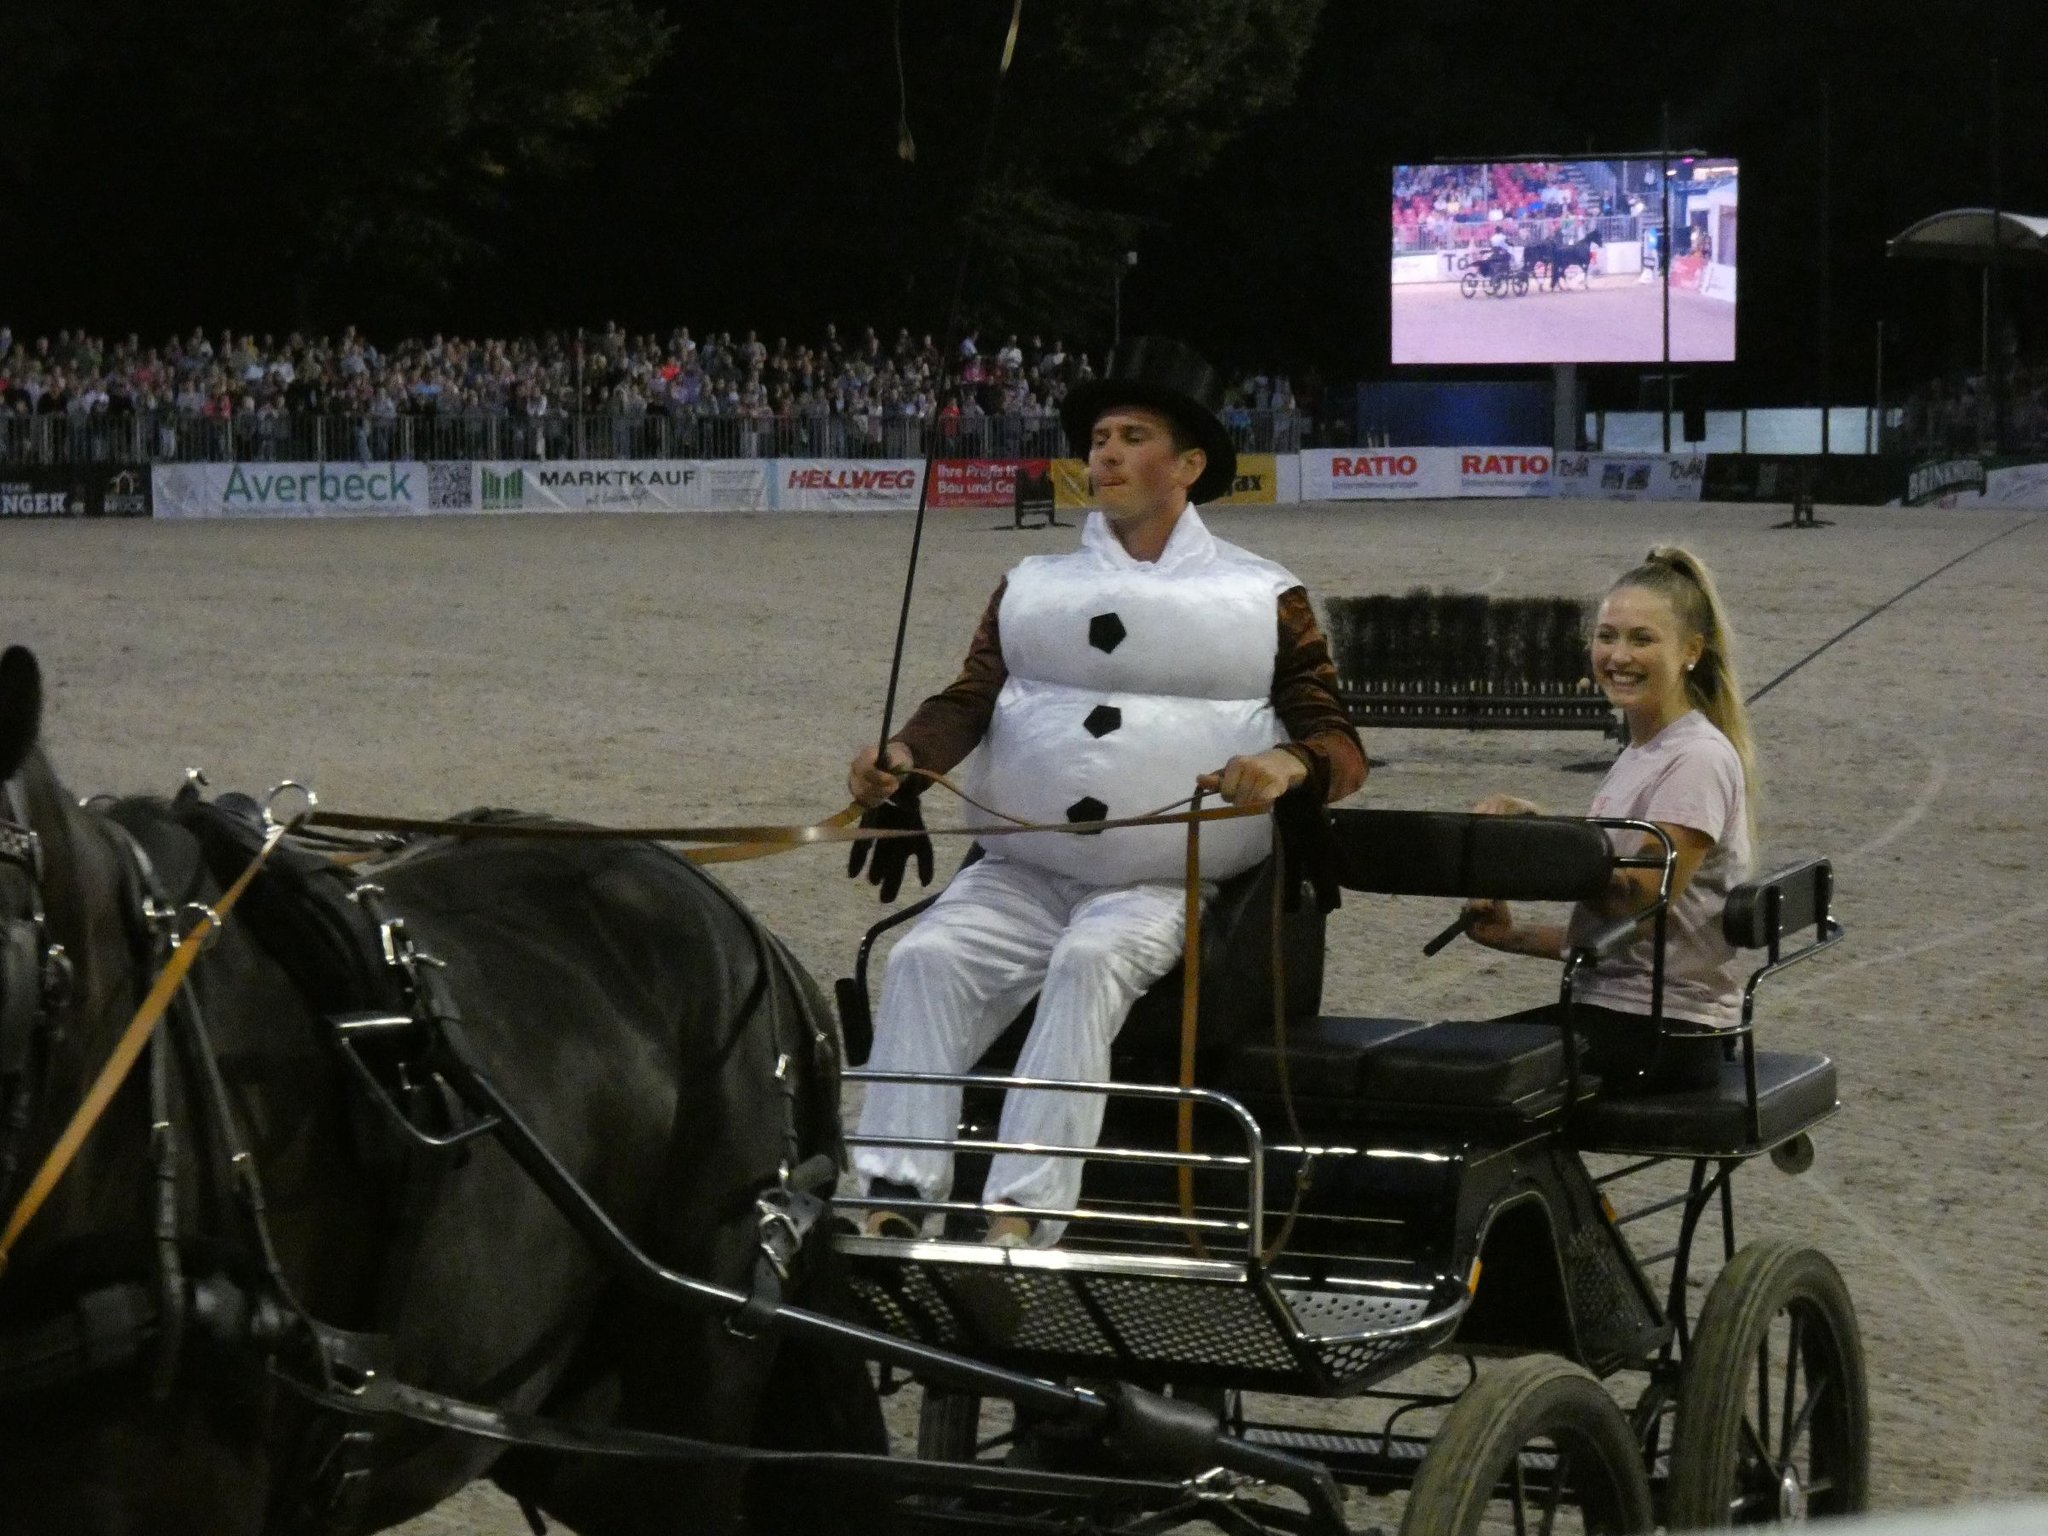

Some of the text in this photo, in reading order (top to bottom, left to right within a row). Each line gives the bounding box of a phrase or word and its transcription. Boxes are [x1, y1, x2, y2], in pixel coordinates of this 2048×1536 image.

[938, 464, 963, 478] Ihre
[1331, 455, 1418, 477] RATIO
[1462, 454, 1550, 475] RATIO
[222, 463, 412, 503] Averbeck
[539, 470, 697, 487] MARKTKAUF
[788, 469, 916, 489] HELLWEG
[938, 480, 963, 494] Bau
[967, 480, 993, 494] und
